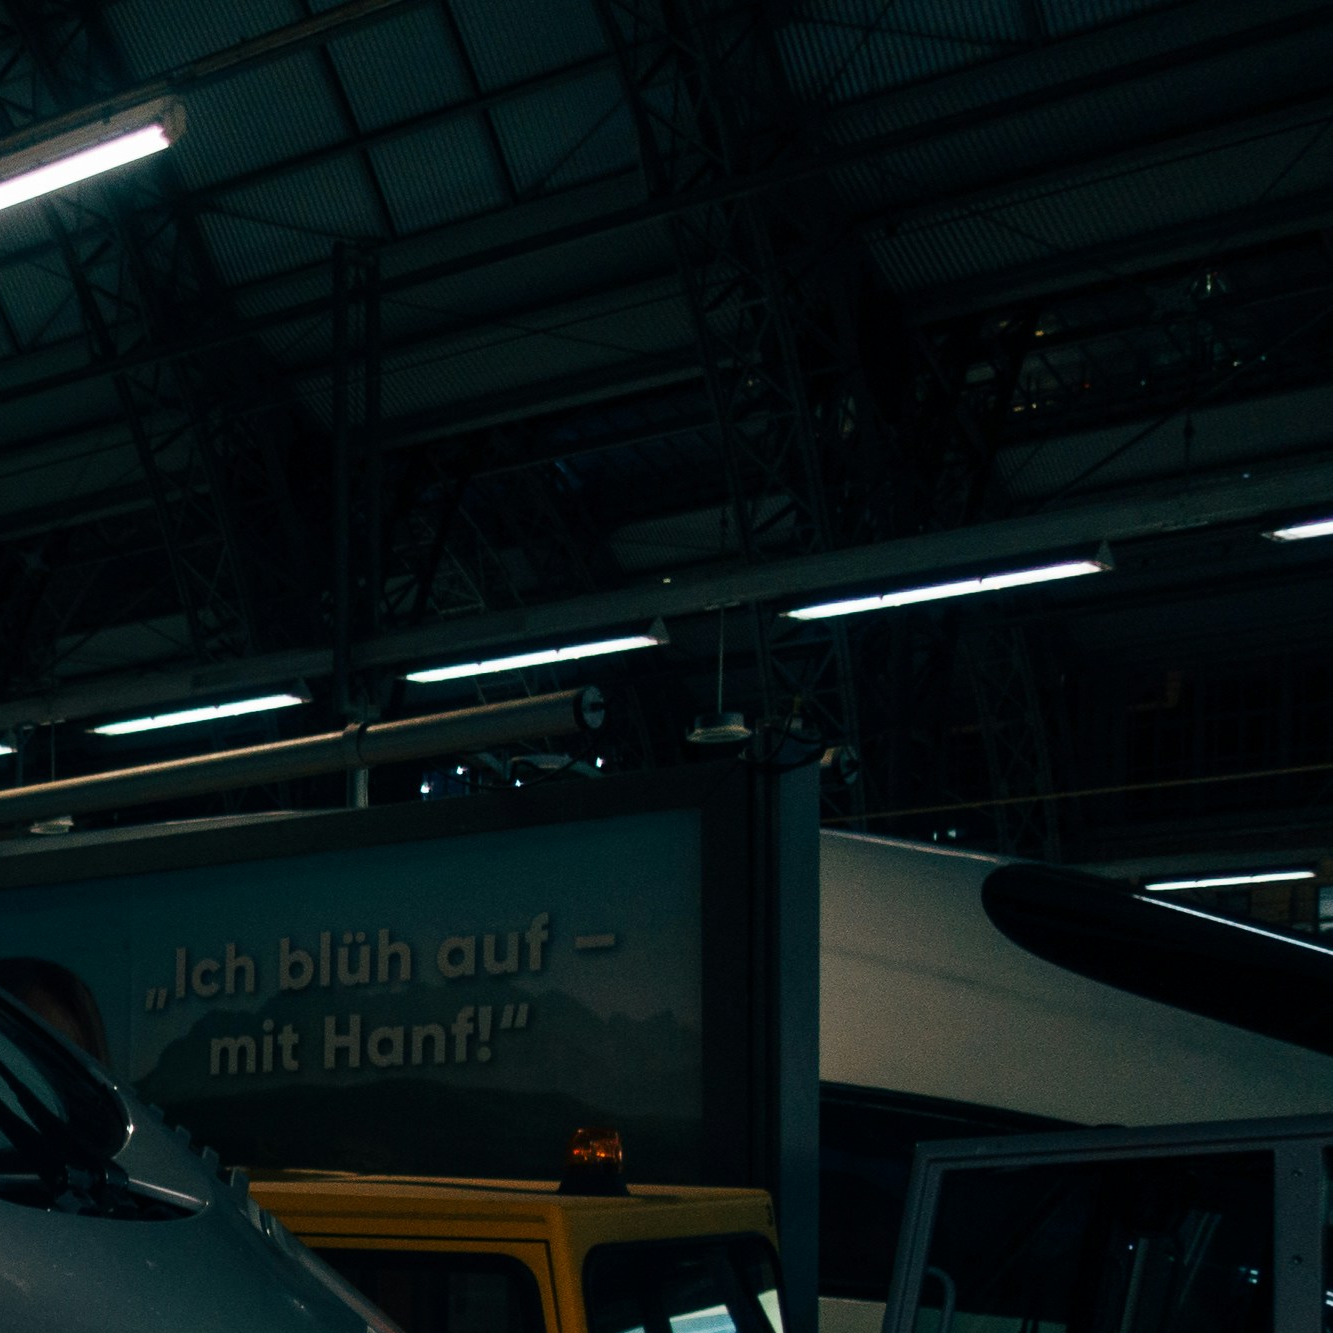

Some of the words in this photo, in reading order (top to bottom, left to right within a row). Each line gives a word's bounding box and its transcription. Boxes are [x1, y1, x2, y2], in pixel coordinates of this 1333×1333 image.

[278, 927, 412, 991] blüh
[436, 912, 550, 979] auf
[209, 1018, 300, 1076] mit
